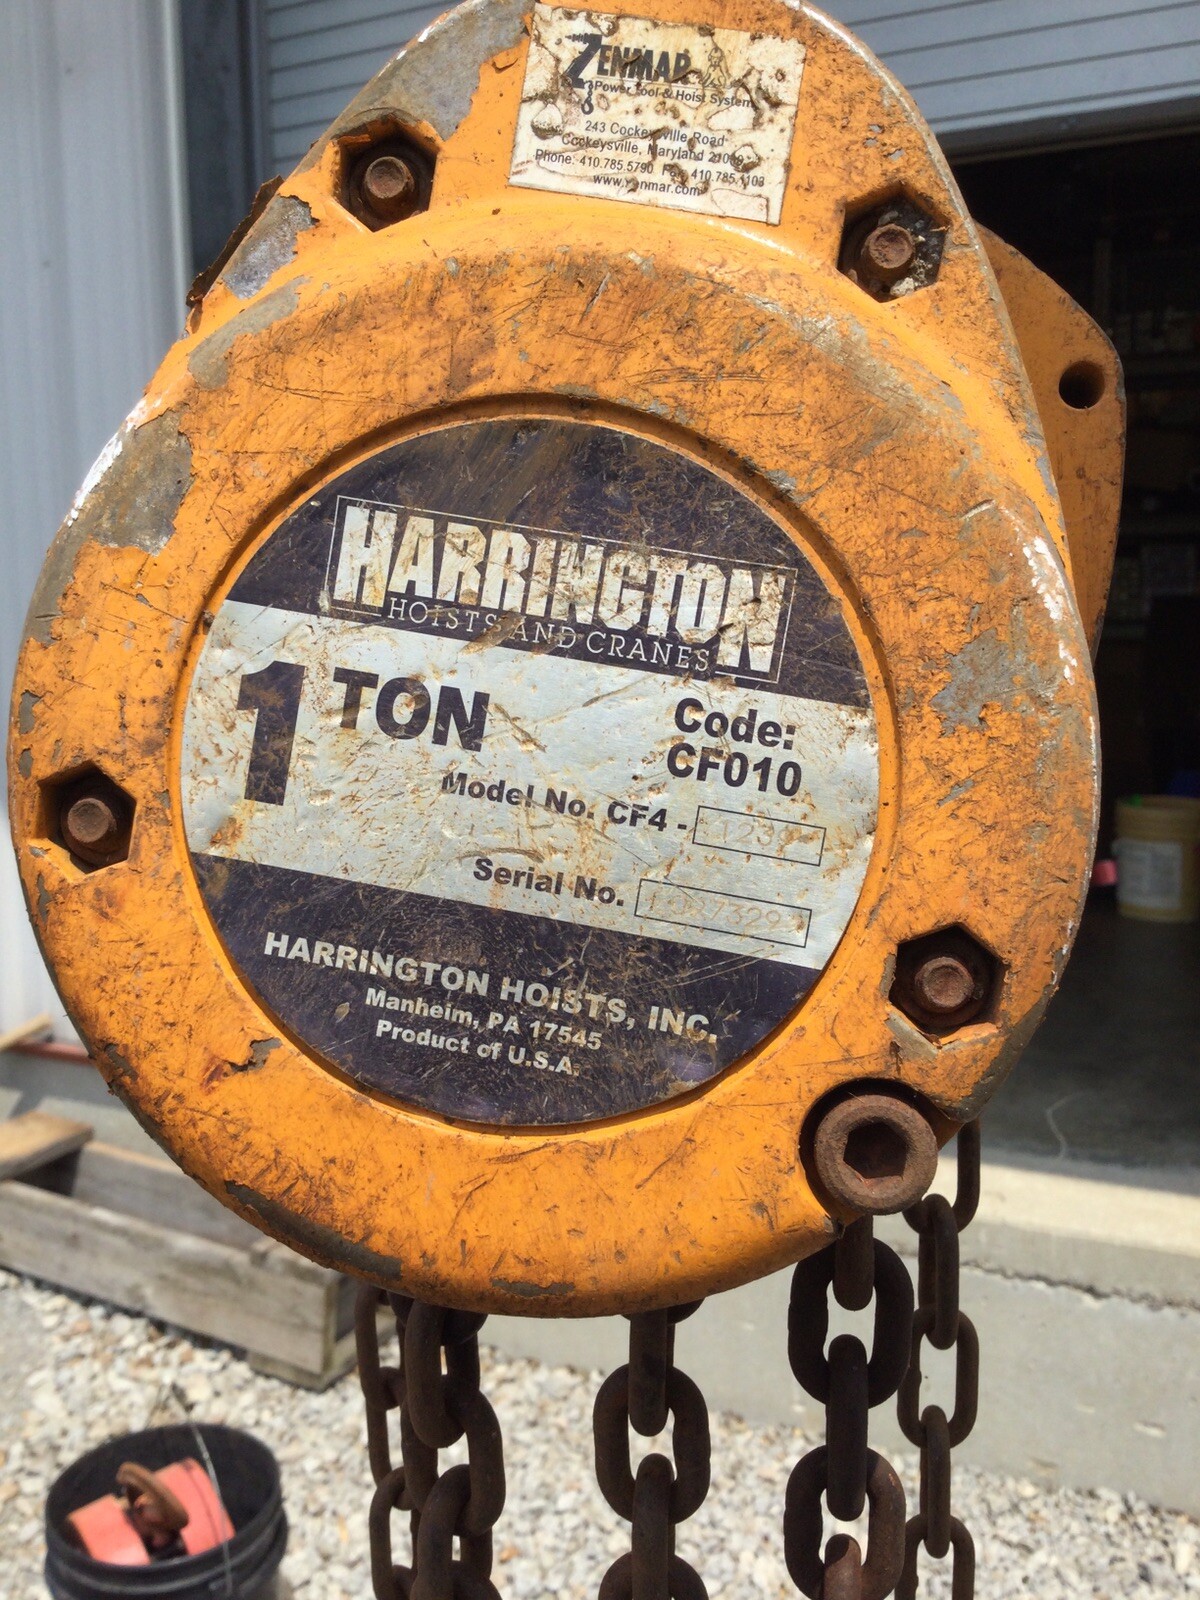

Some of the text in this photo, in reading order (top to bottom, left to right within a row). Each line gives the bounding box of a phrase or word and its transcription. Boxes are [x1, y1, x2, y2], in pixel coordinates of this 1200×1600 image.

[594, 81, 631, 96] Power
[664, 86, 674, 99] &
[676, 90, 706, 105] Hoist
[561, 132, 642, 156] Cockeysville,
[647, 143, 704, 161] Maryland
[585, 120, 725, 146] 243 Cockeyville Road
[535, 149, 575, 165] Phone:
[580, 155, 654, 174] 410.785.5790
[593, 174, 701, 197] www.nmar.com
[334, 505, 785, 673] HARRINGTON
[388, 596, 709, 671] HOISTS AND CRANES
[237, 660, 491, 806] 1 TON
[674, 697, 797, 750] Code:
[666, 742, 802, 797] CF010
[441, 772, 535, 808] Model
[544, 790, 595, 820] No.
[607, 800, 668, 832] CF4
[473, 857, 625, 907] Serial No.
[264, 931, 719, 1044] HARRINGTON HOISTS, INC.
[365, 987, 602, 1051] Manheim, PA 17545
[375, 1019, 580, 1076] Product of U.S.A.
